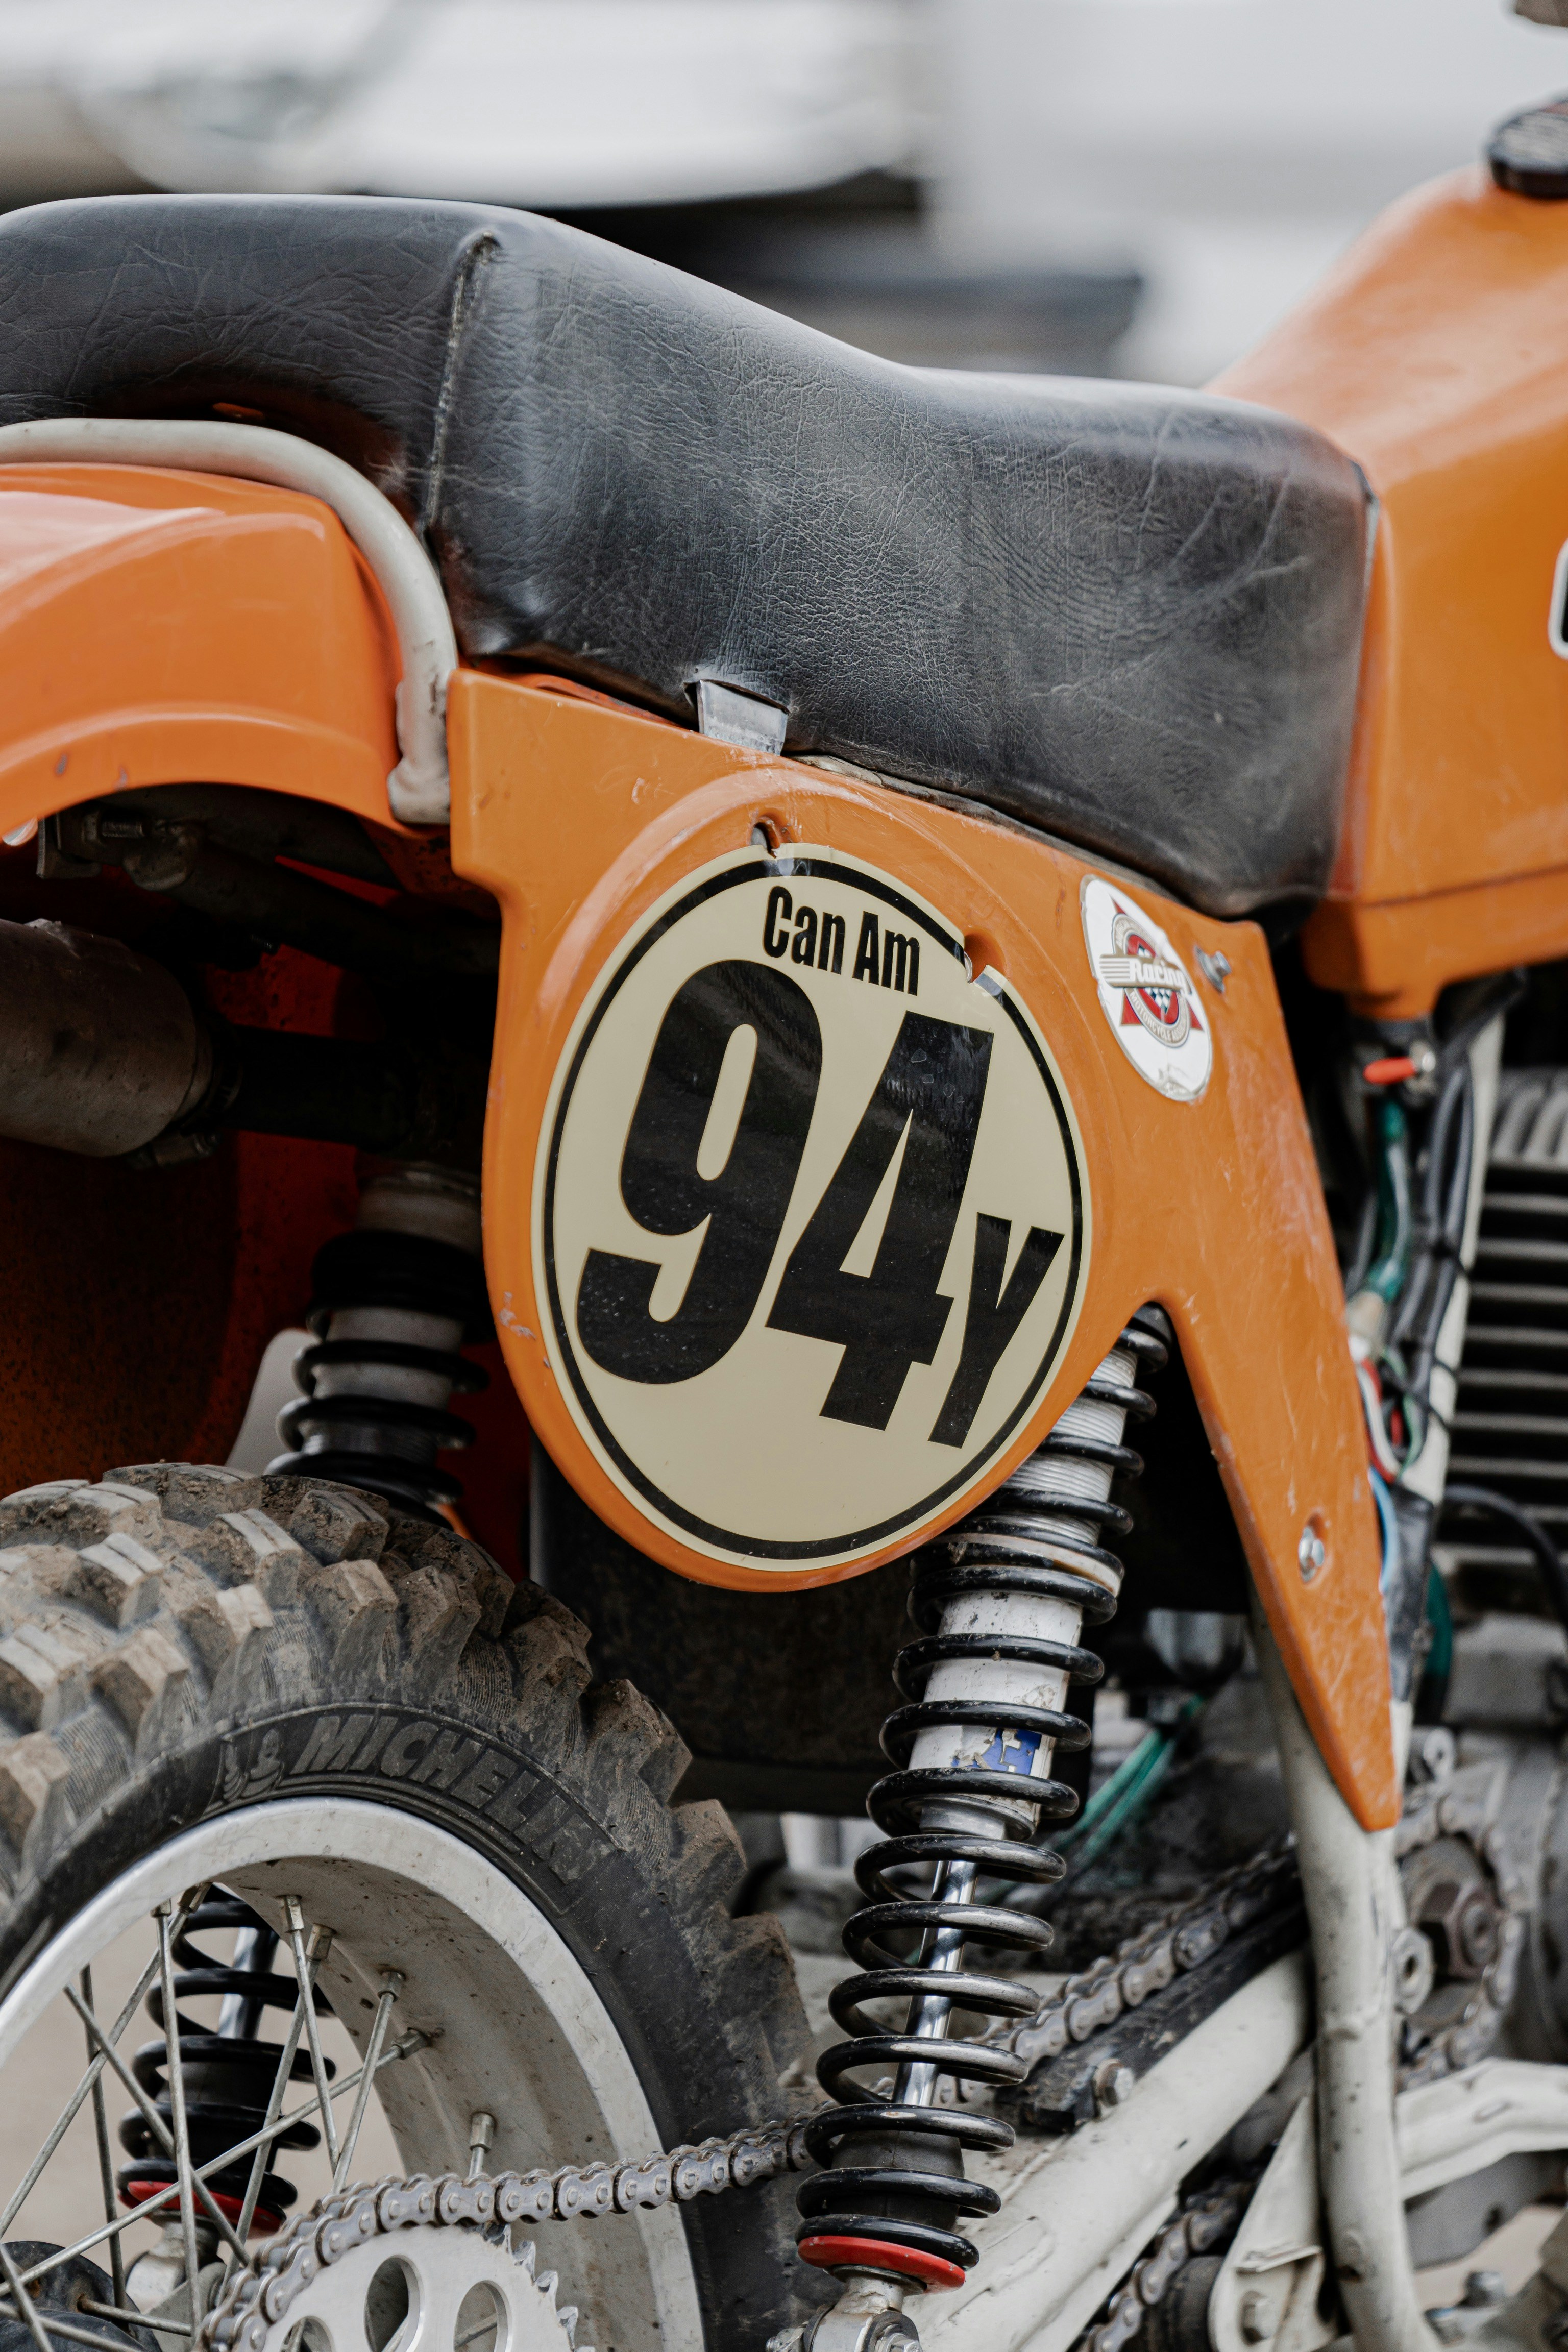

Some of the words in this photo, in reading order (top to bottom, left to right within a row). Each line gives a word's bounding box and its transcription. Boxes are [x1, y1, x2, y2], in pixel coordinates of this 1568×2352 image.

[764, 886, 846, 975] Can
[852, 911, 920, 996] Am
[1130, 958, 1188, 996] Racing
[289, 1714, 611, 1885] MICHELIN
